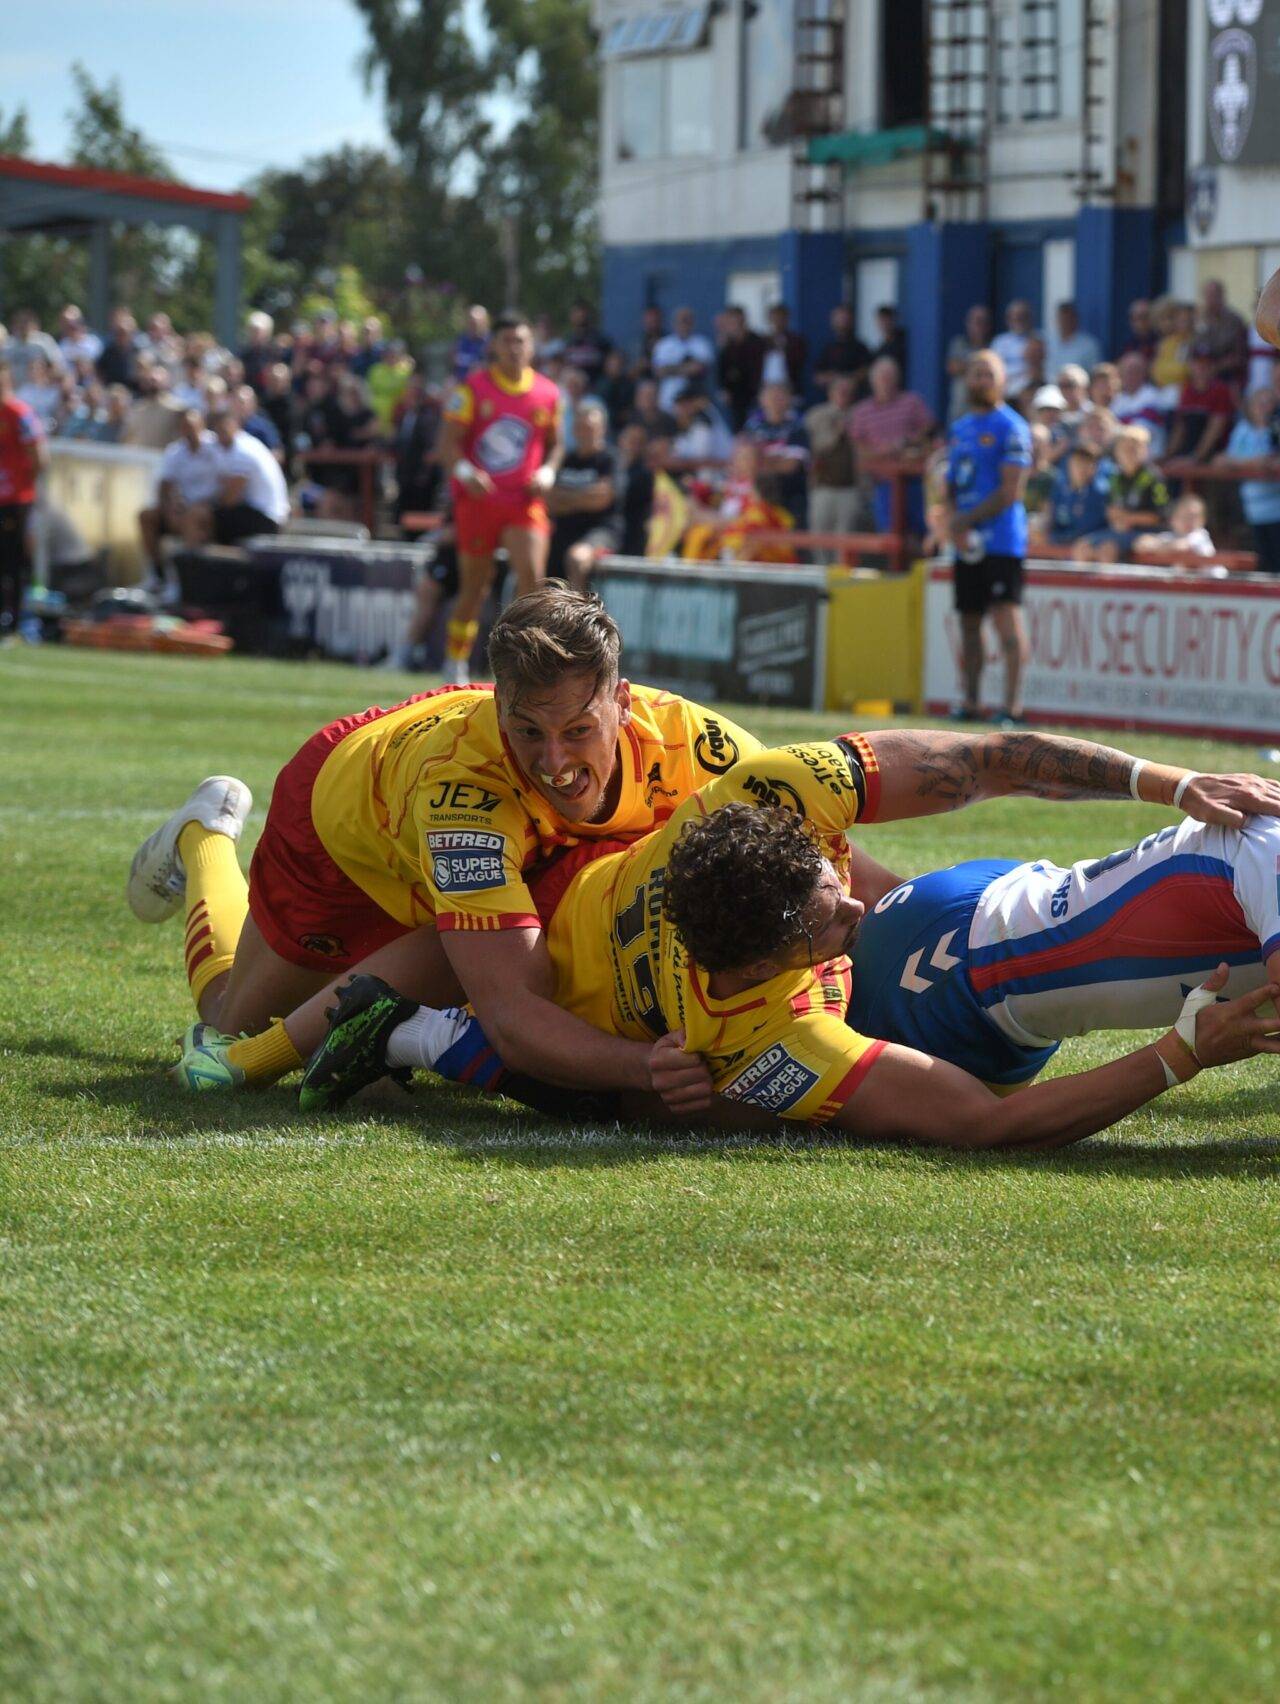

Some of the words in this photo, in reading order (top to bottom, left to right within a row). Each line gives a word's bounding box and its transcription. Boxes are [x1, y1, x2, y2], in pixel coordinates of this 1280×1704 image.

[1100, 601, 1259, 683] SECURITY
[429, 813, 493, 825] TRANSPORTS
[428, 832, 502, 851] BETFRED
[451, 857, 502, 873] SUPER
[452, 870, 502, 884] LEAGUE
[723, 1048, 782, 1100] TFRED
